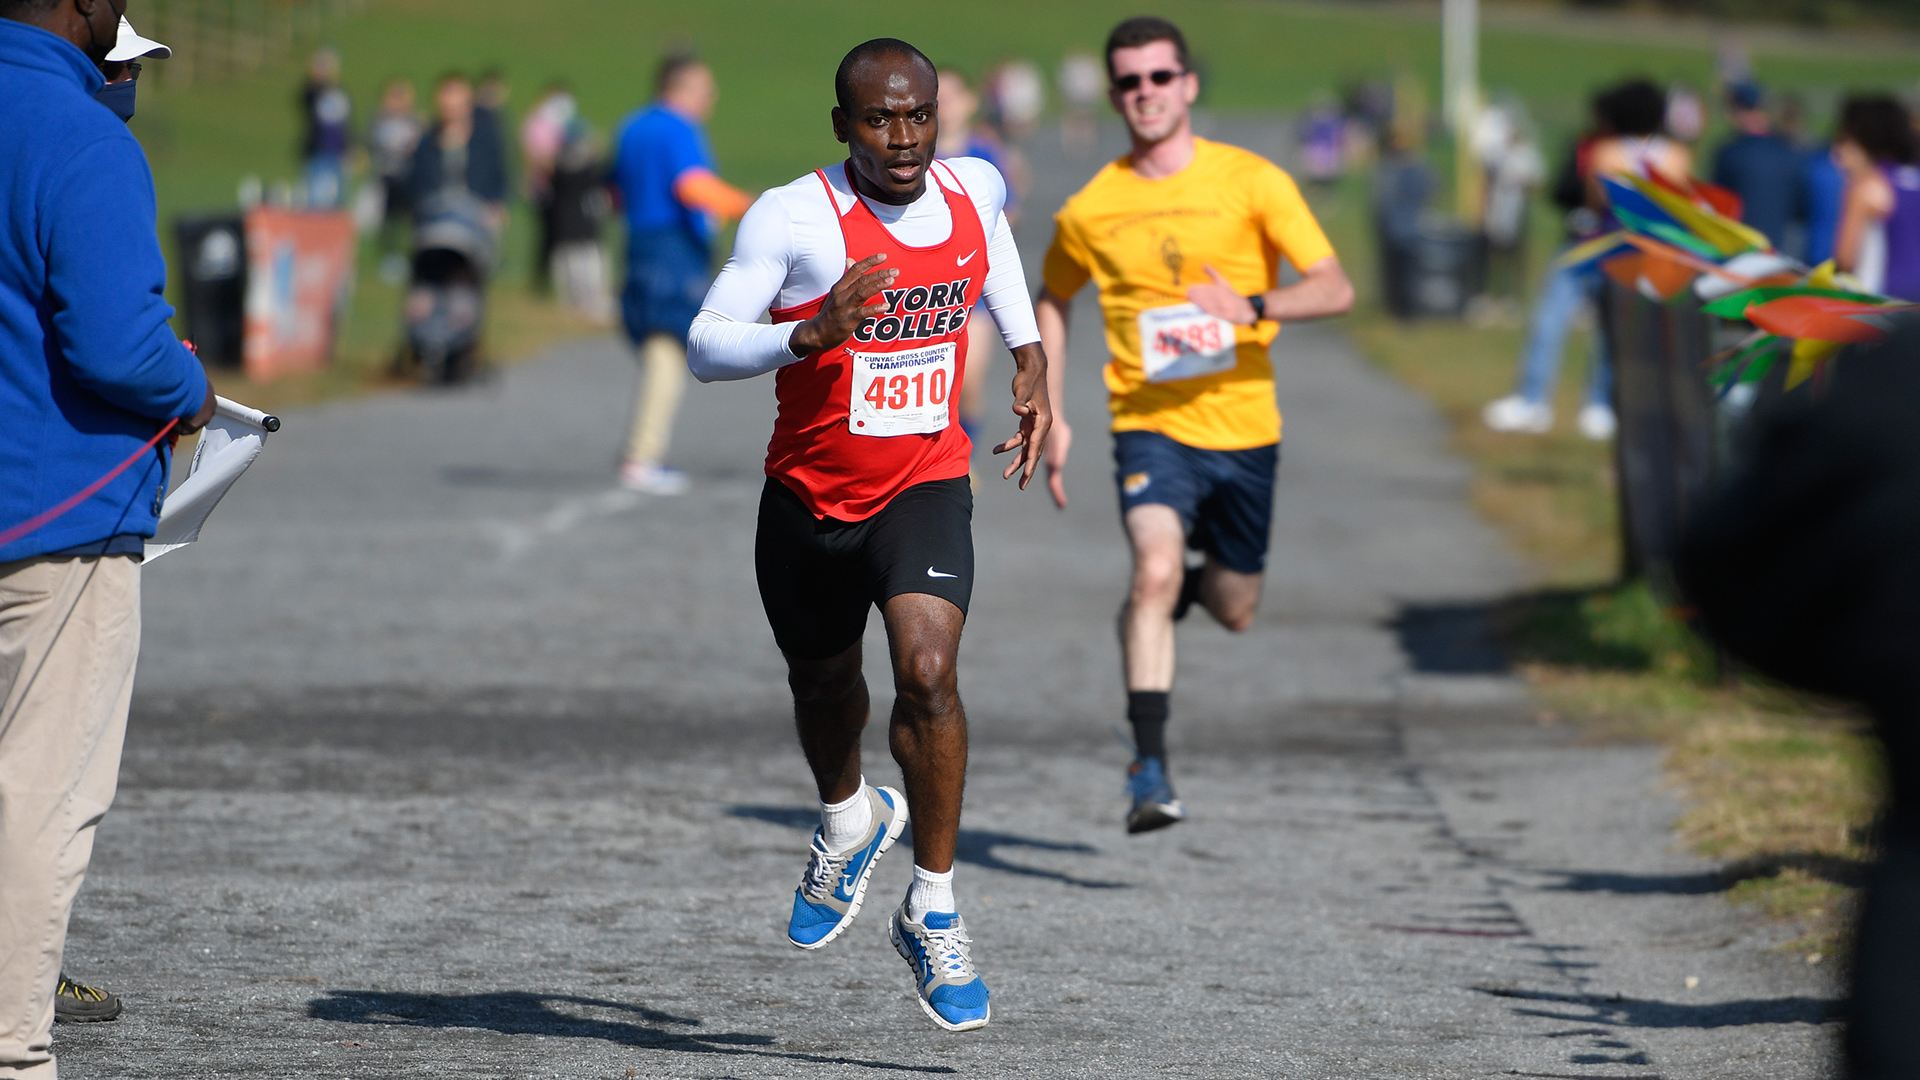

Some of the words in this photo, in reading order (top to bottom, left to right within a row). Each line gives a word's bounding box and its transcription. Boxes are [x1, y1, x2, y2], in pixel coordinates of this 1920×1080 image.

[882, 277, 971, 315] YORK
[853, 305, 973, 343] COLLEG
[869, 353, 945, 370] CHAMPIONSHIPS
[896, 353, 919, 361] CROSS
[920, 347, 949, 358] COUNTRY
[864, 368, 947, 410] 4310
